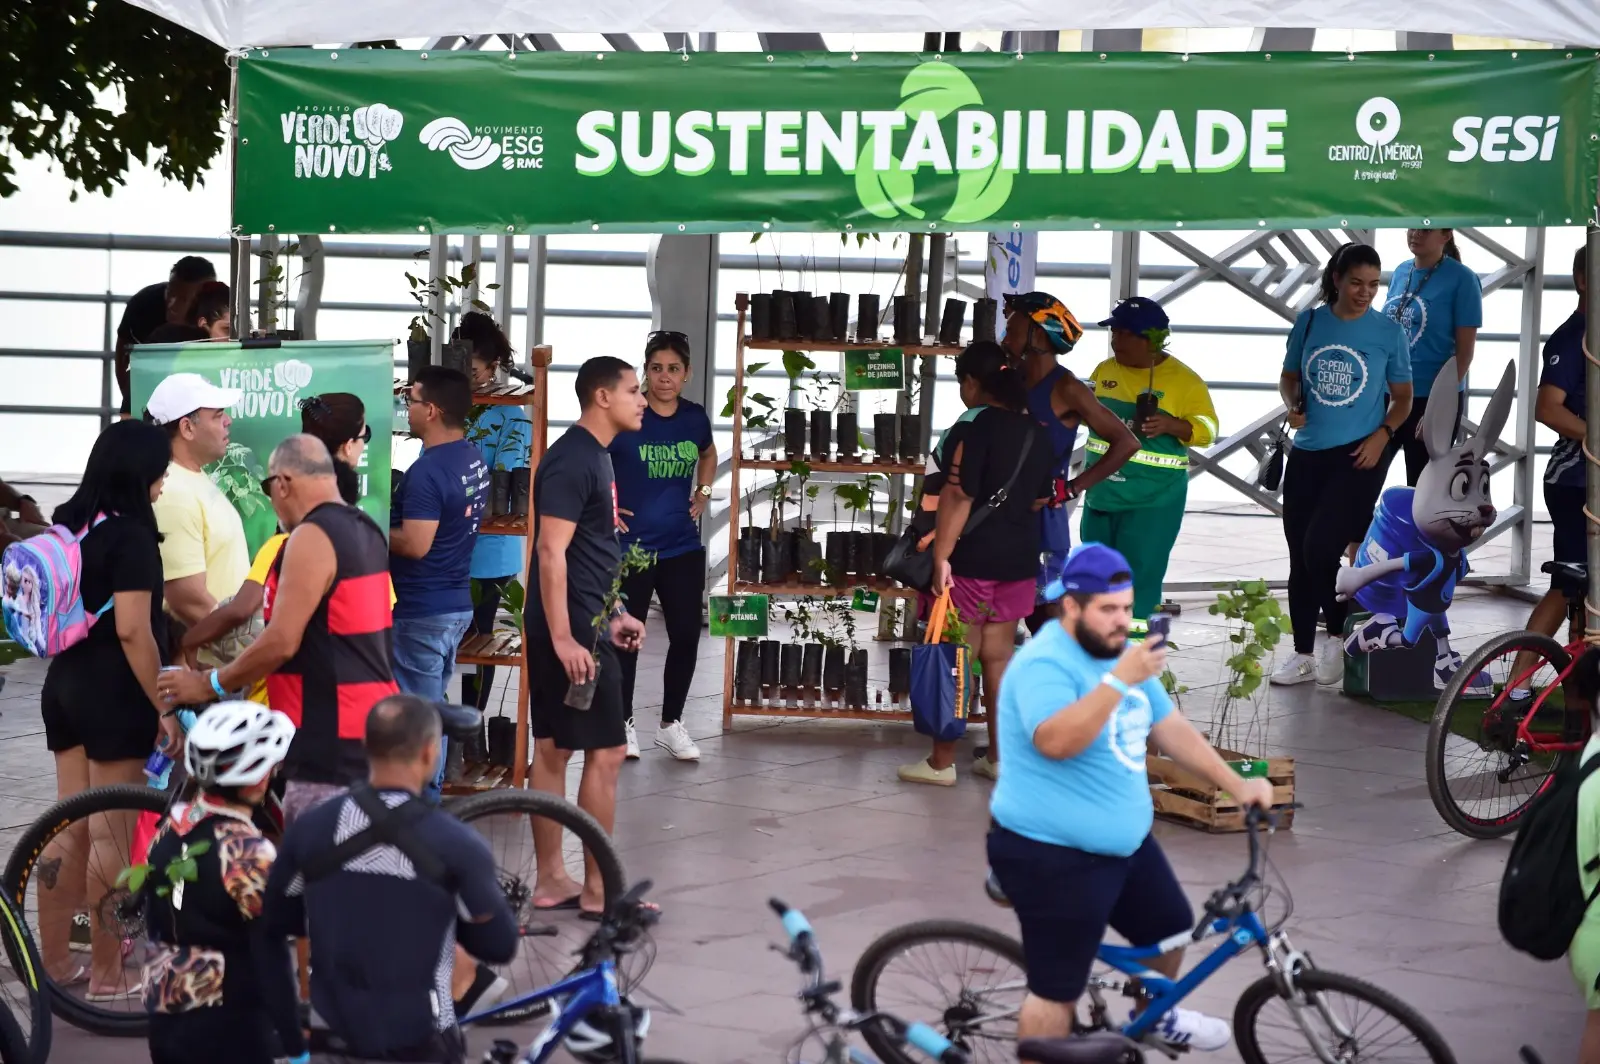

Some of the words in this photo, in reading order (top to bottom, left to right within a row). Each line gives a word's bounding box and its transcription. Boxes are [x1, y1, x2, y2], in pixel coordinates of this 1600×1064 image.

[280, 111, 353, 145] VERDE
[474, 125, 543, 135] MOVIMENTO
[501, 135, 544, 156] ESG
[575, 109, 1288, 176] SUSTENTABILIDADE
[1447, 115, 1561, 163] SESI
[294, 144, 366, 179] NOVO
[1328, 145, 1370, 161] CENTRO
[516, 157, 543, 169] RMC
[867, 363, 896, 371] IPEZINHO
[876, 371, 899, 379] JARDIM
[1328, 360, 1354, 374] PEDAL
[219, 367, 274, 392] VERDE
[1317, 370, 1352, 386] CENTRO
[230, 391, 285, 419] NOVO
[638, 444, 678, 462] VERDE
[647, 460, 685, 479] NOVO
[730, 613, 759, 621] PITANGA
